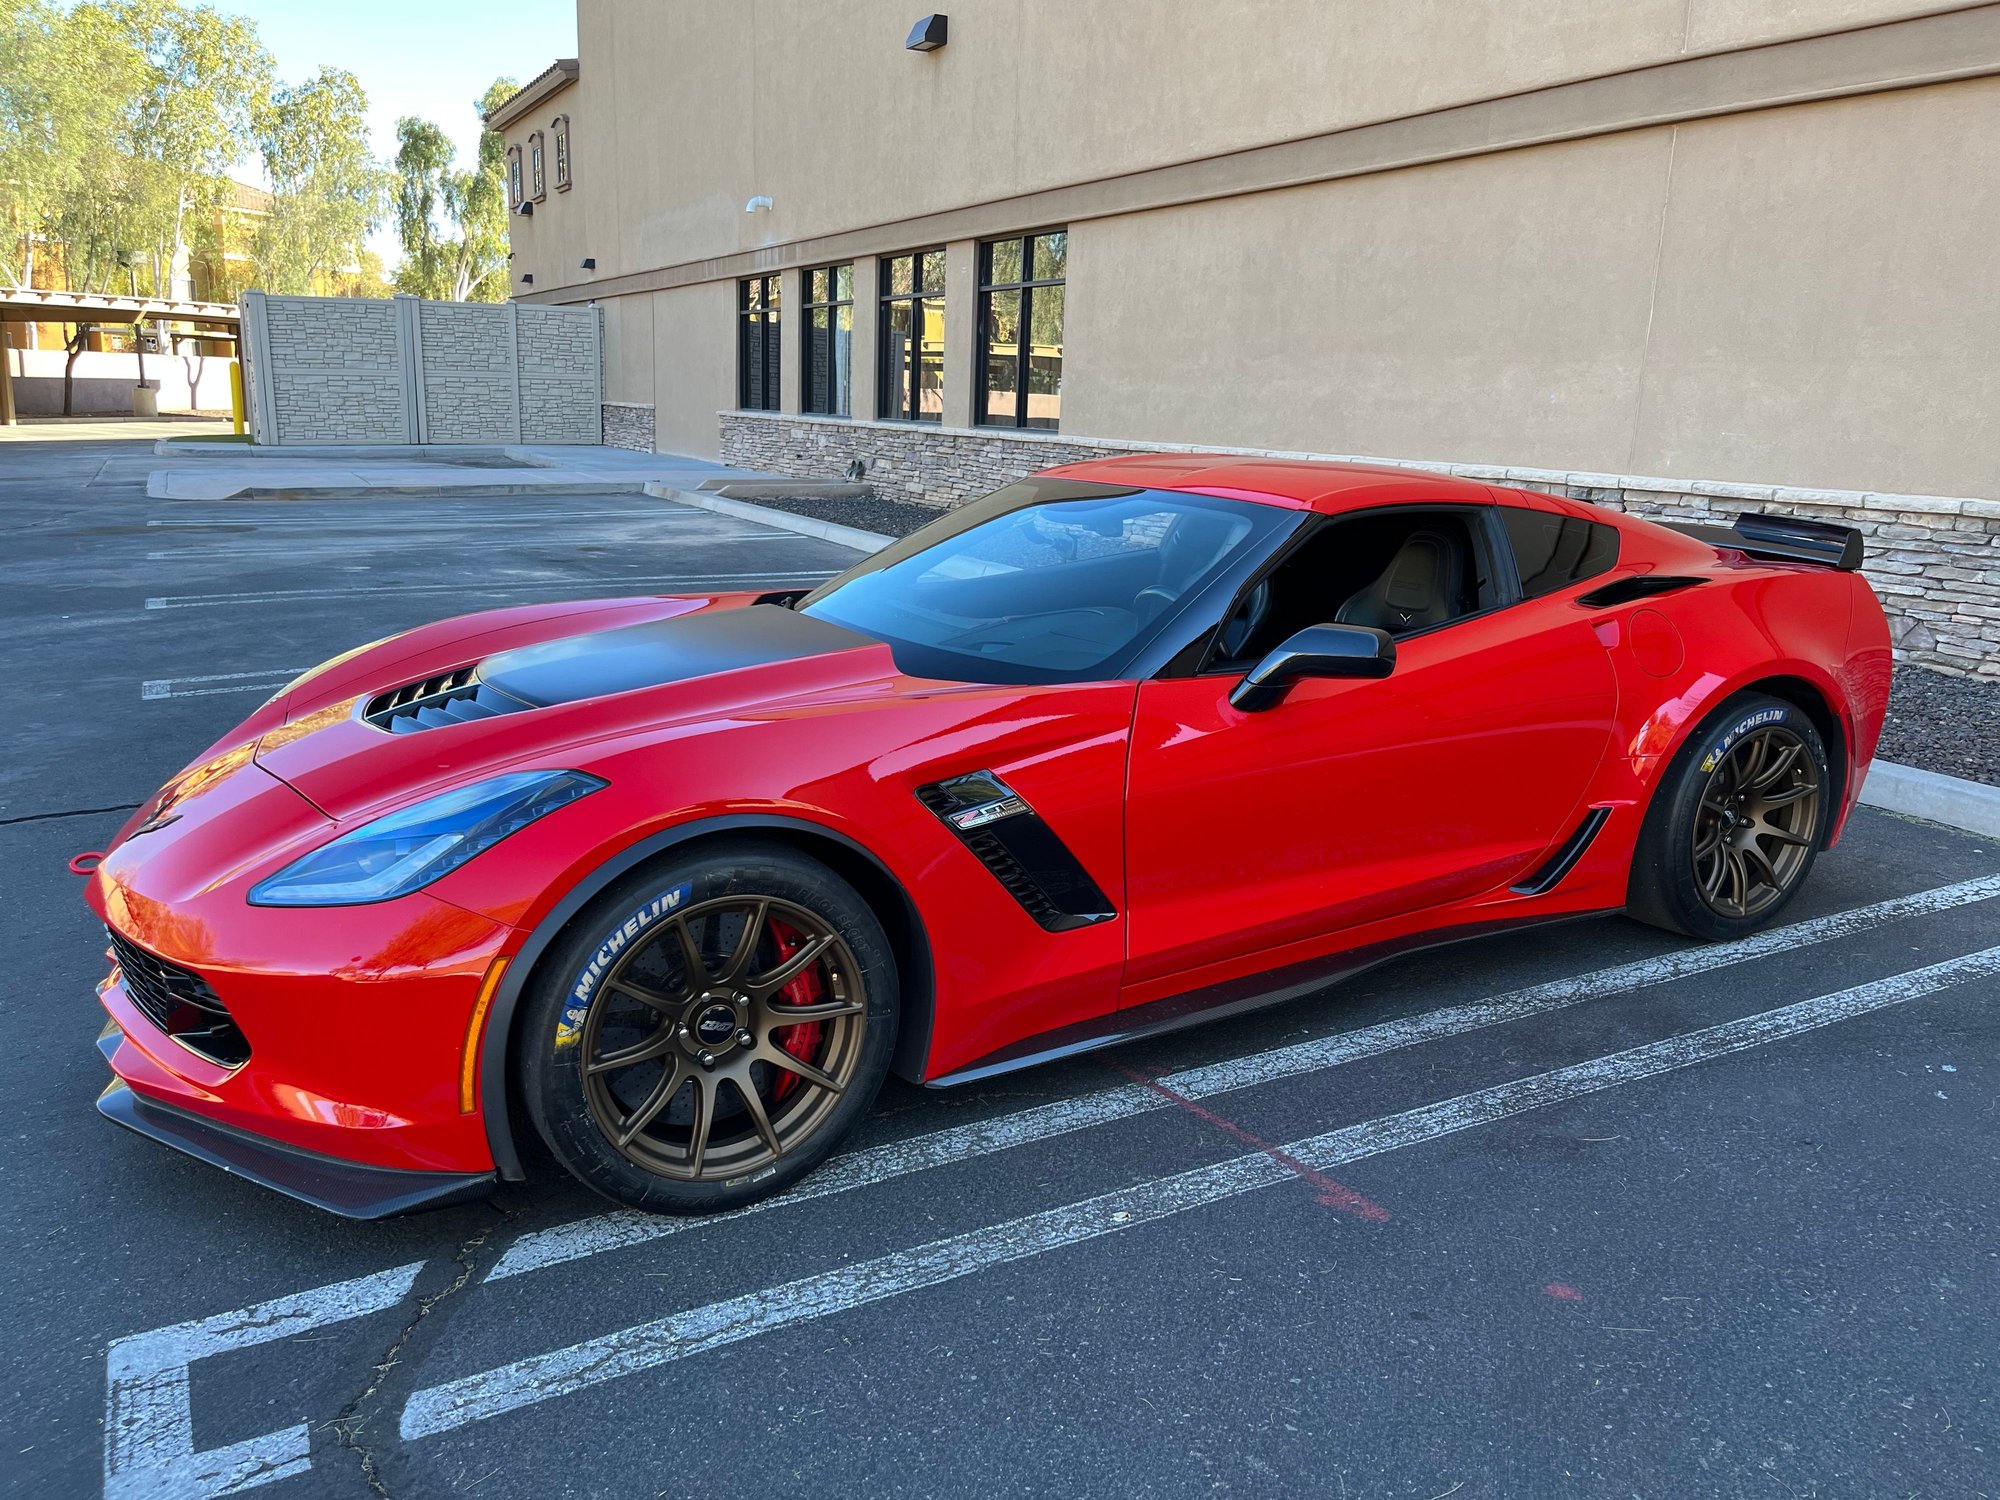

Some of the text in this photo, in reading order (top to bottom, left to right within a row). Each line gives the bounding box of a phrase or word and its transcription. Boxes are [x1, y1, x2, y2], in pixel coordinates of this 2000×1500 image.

[575, 889, 680, 1002] MICHELIN
[797, 888, 871, 953] PILOT SPORT
